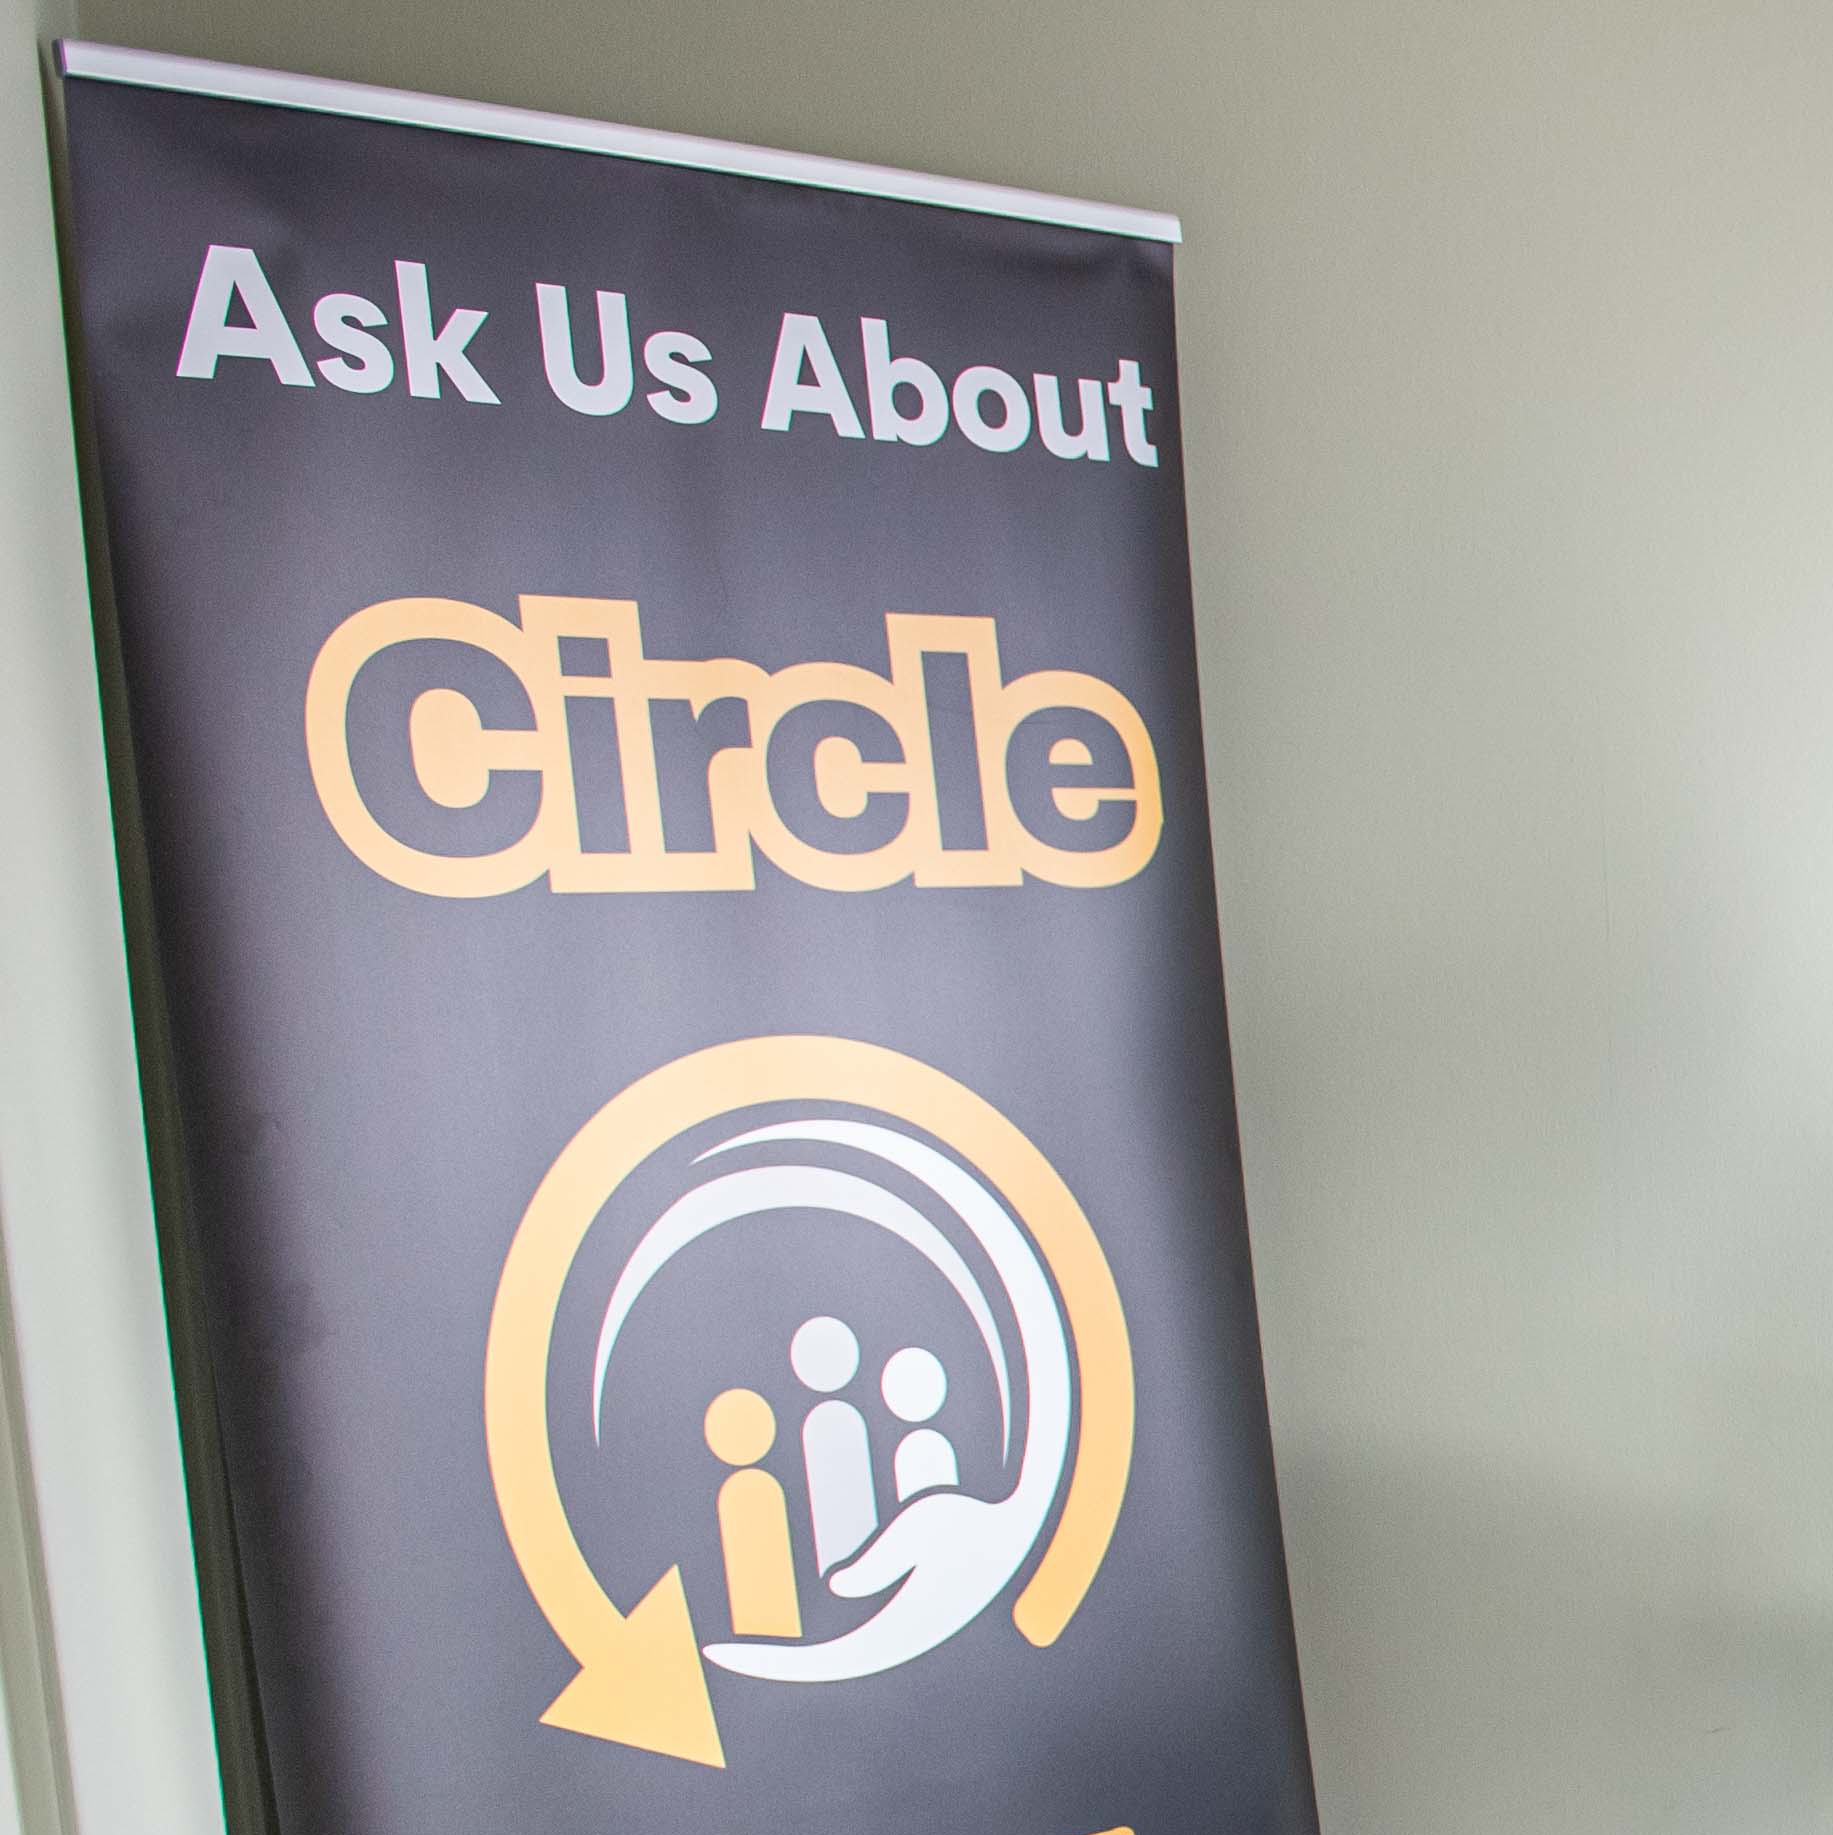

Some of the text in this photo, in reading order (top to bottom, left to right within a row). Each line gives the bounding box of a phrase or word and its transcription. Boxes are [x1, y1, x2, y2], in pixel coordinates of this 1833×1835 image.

[177, 244, 1160, 468] Ask Us About
[304, 594, 1165, 899] Circle
